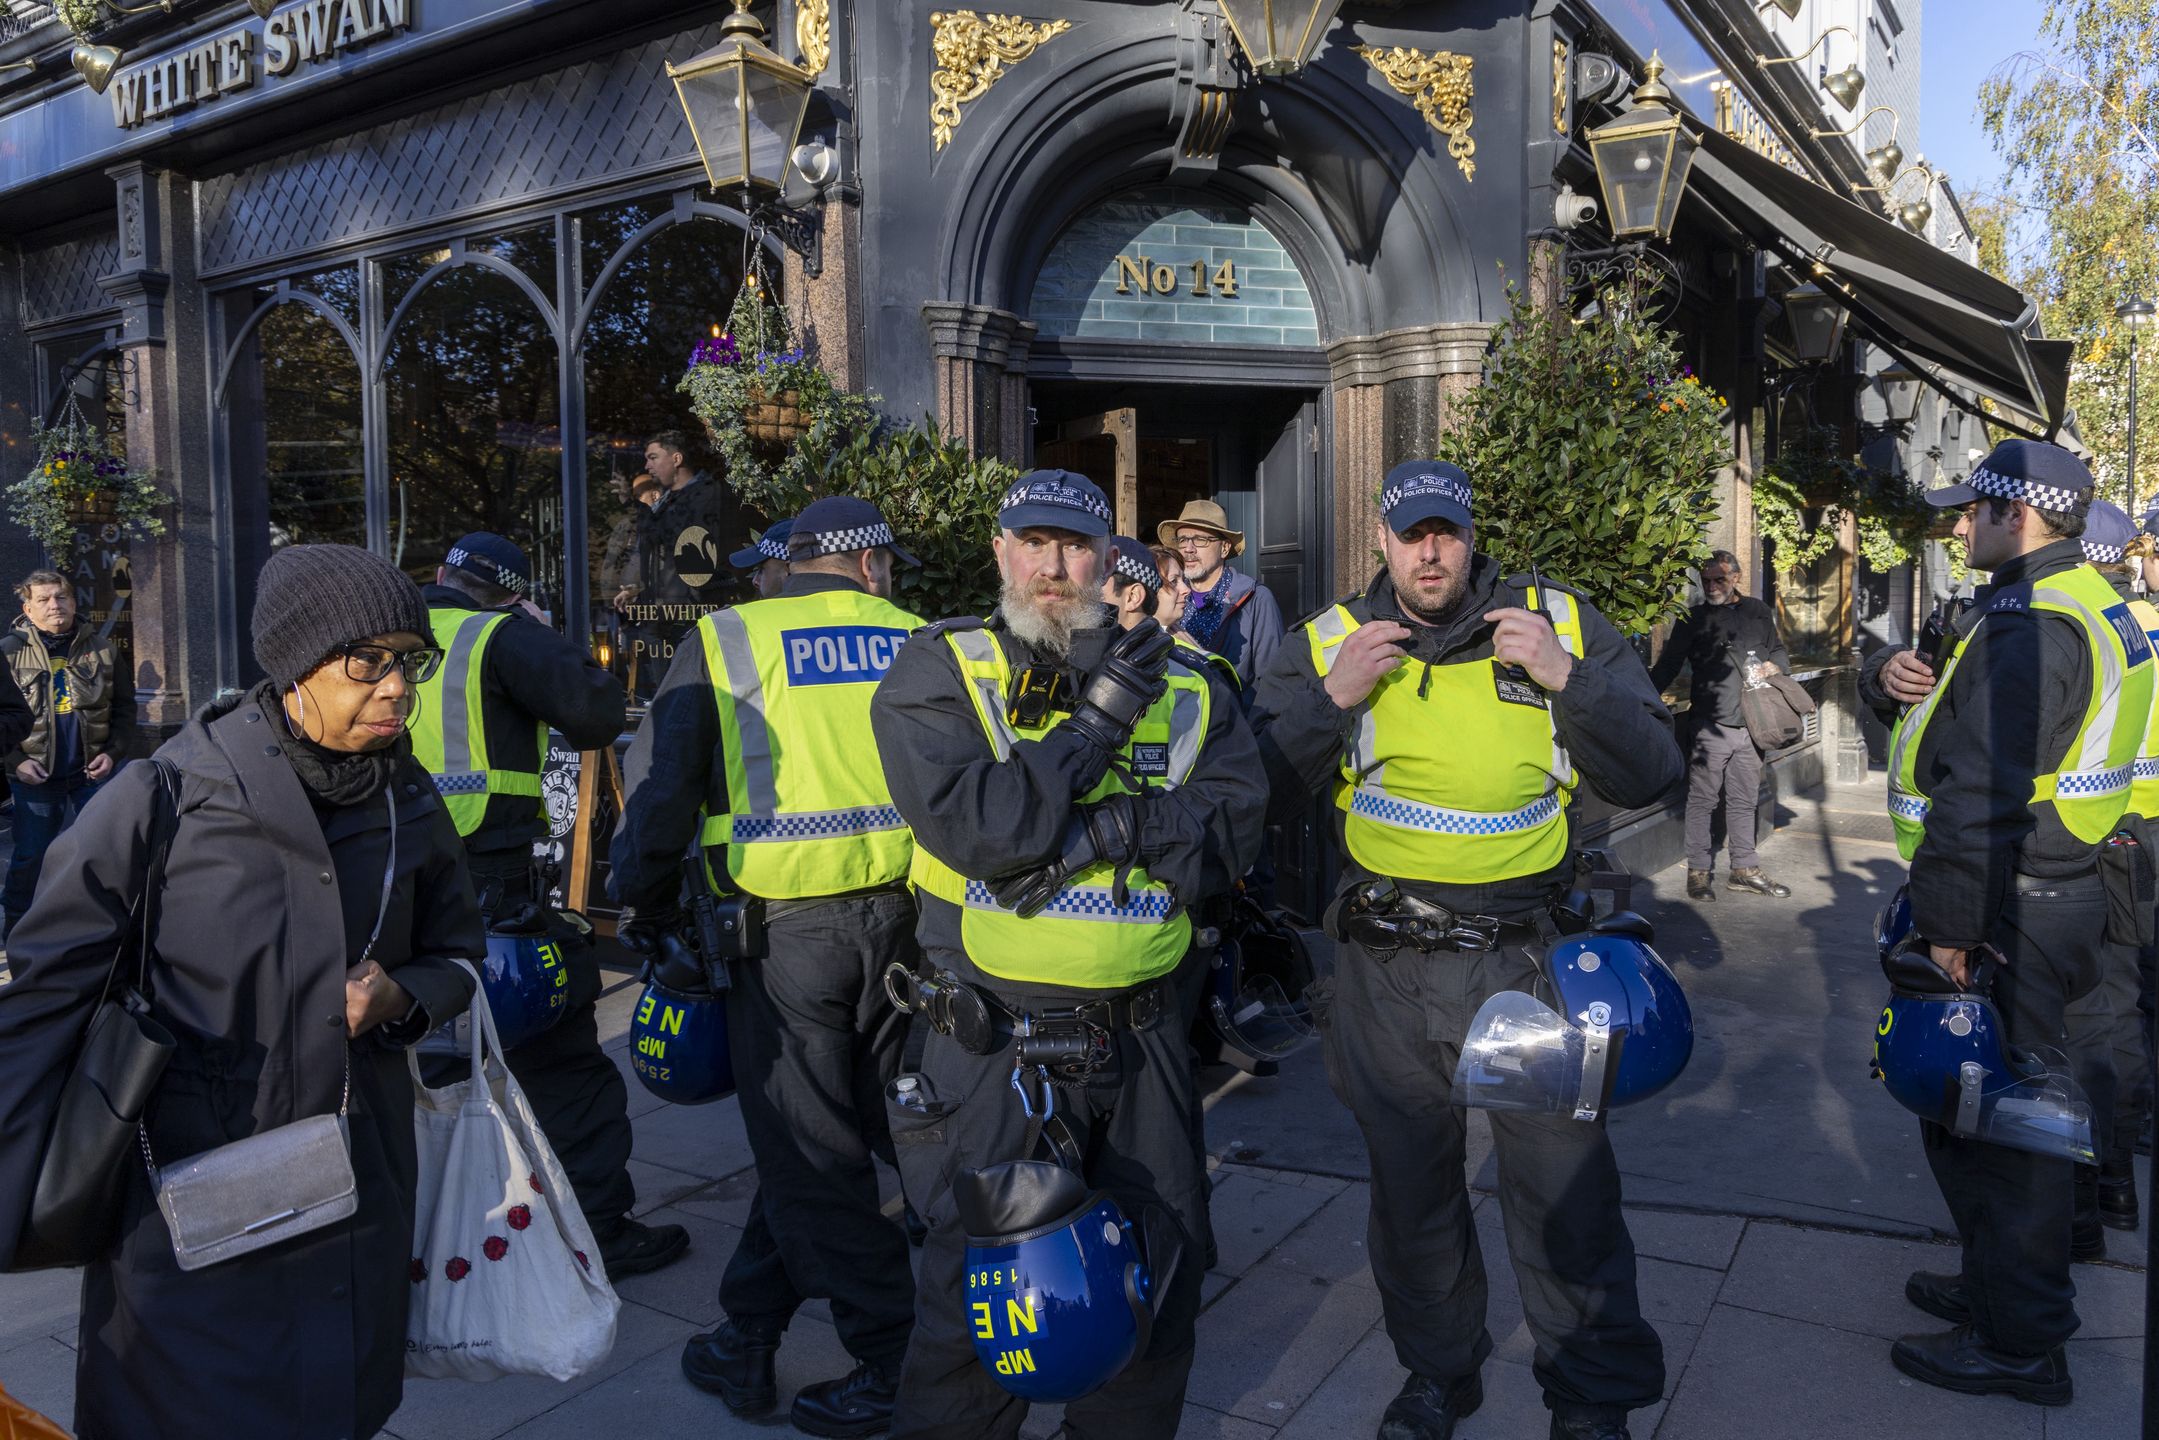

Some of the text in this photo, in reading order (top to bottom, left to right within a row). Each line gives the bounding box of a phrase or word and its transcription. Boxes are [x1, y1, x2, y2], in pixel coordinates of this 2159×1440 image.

[109, 0, 409, 128] WHITE SWAN
[1115, 255, 1236, 295] No 14
[1403, 487, 1453, 498] POLICE OFFICER
[1423, 479, 1446, 487] POLICE
[1028, 493, 1083, 507] POLICE OFFICER
[626, 604, 659, 621] THE
[2112, 612, 2148, 656] POLIC
[550, 746, 580, 762] Swan
[637, 995, 686, 1036] NE
[638, 1035, 666, 1059] MP
[970, 1267, 1019, 1289] 1586
[995, 1347, 1037, 1375] MP
